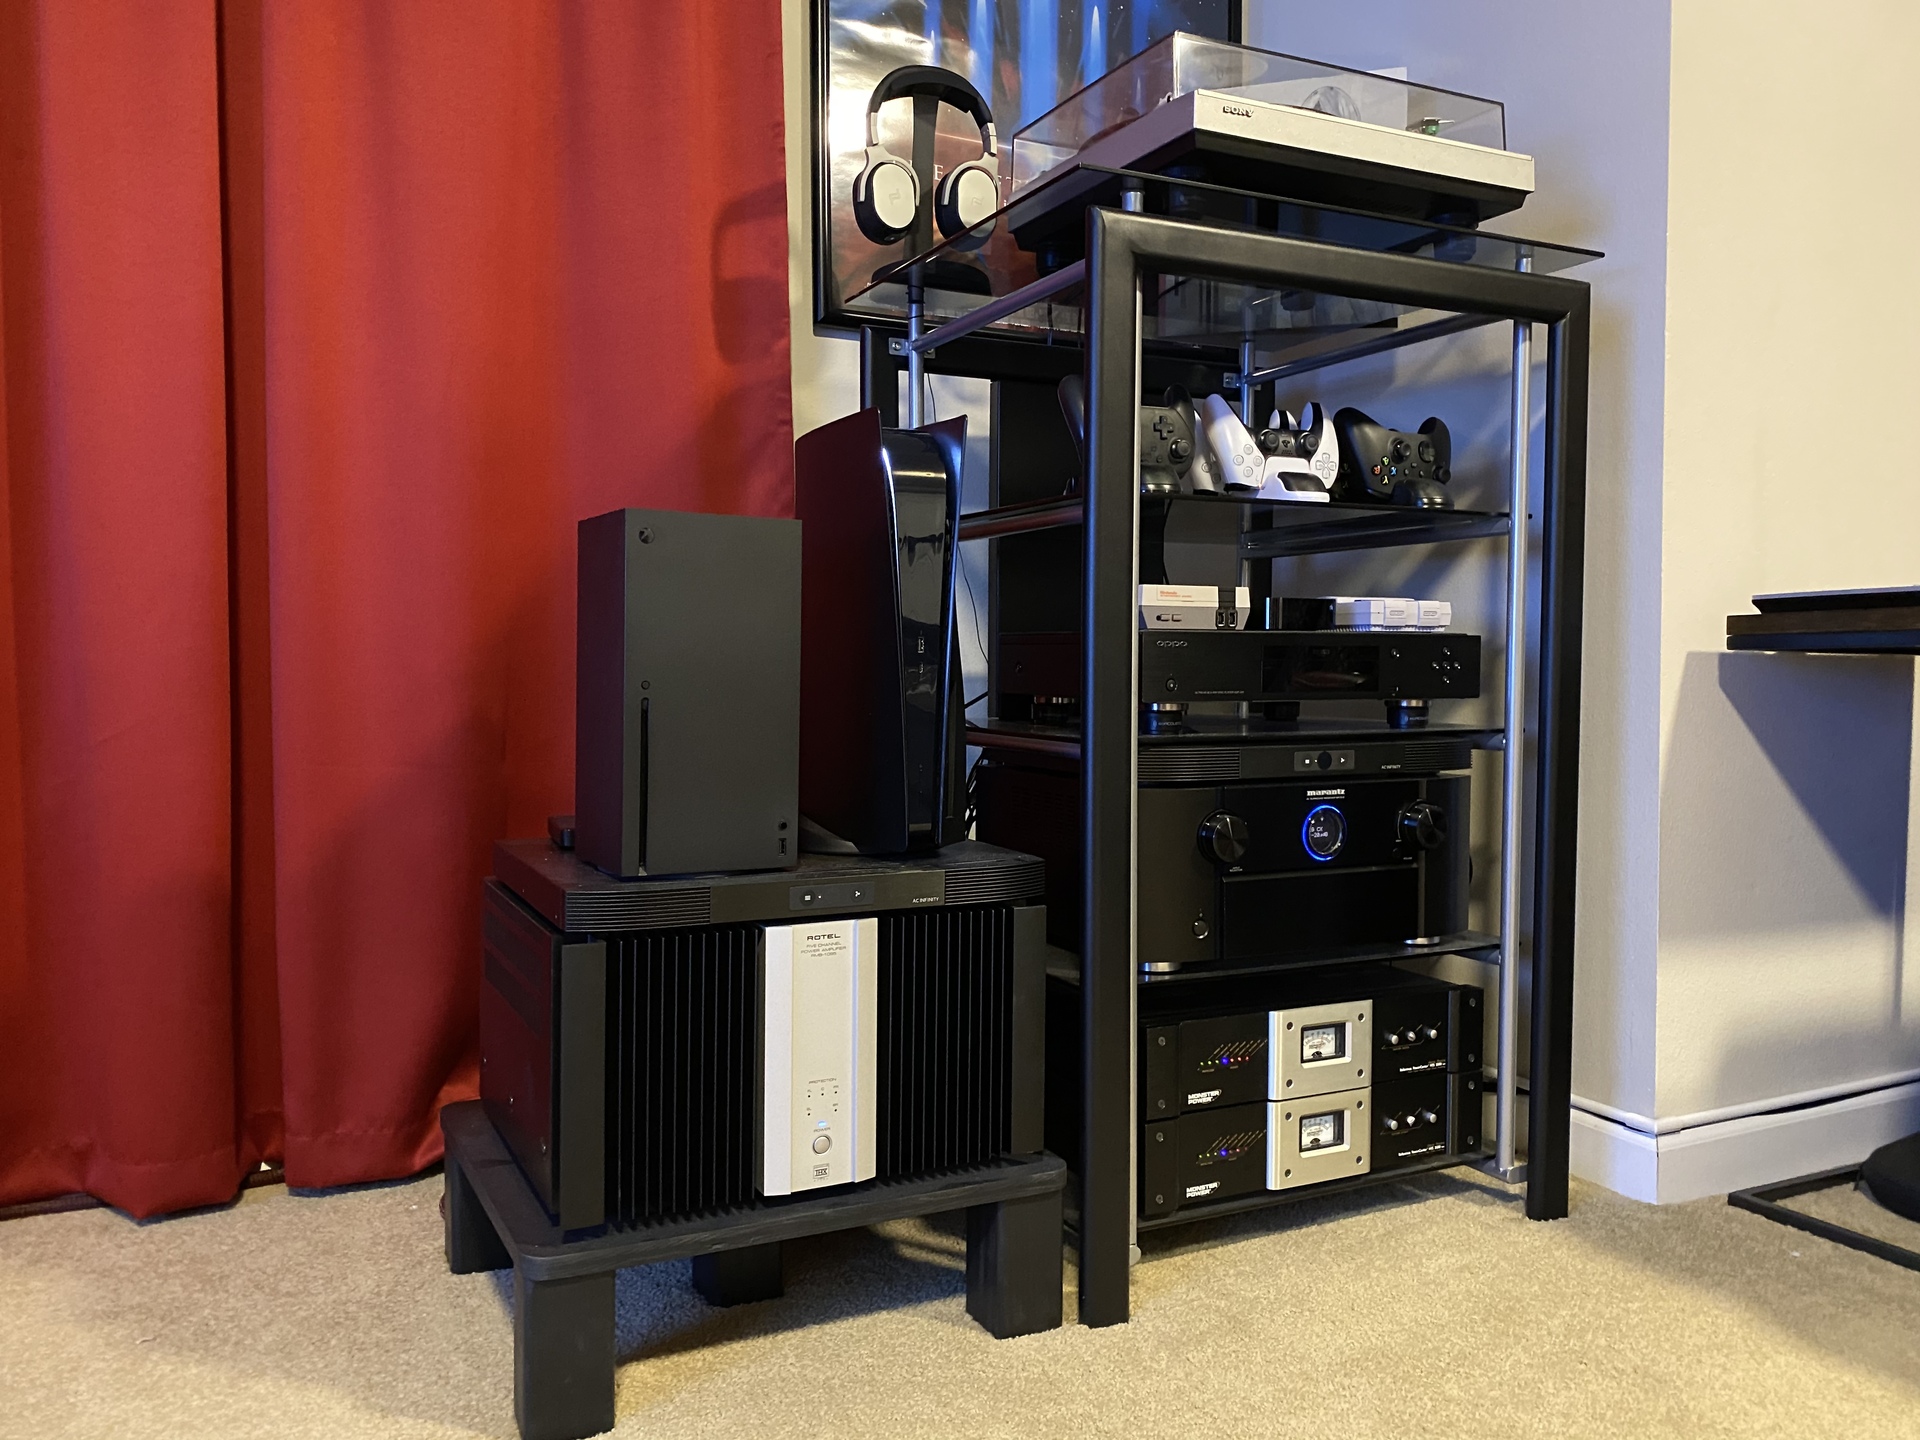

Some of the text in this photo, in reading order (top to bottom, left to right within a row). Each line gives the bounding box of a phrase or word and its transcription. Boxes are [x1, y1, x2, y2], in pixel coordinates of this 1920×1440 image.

[1222, 105, 1254, 118] SONY
[1306, 788, 1346, 796] marantz
[806, 933, 842, 941] ROTEL
[1187, 1090, 1220, 1100] MONSTER
[1187, 1097, 1213, 1105] POWER
[1186, 1182, 1218, 1193] MONSTER
[1186, 1189, 1212, 1199] POWER
